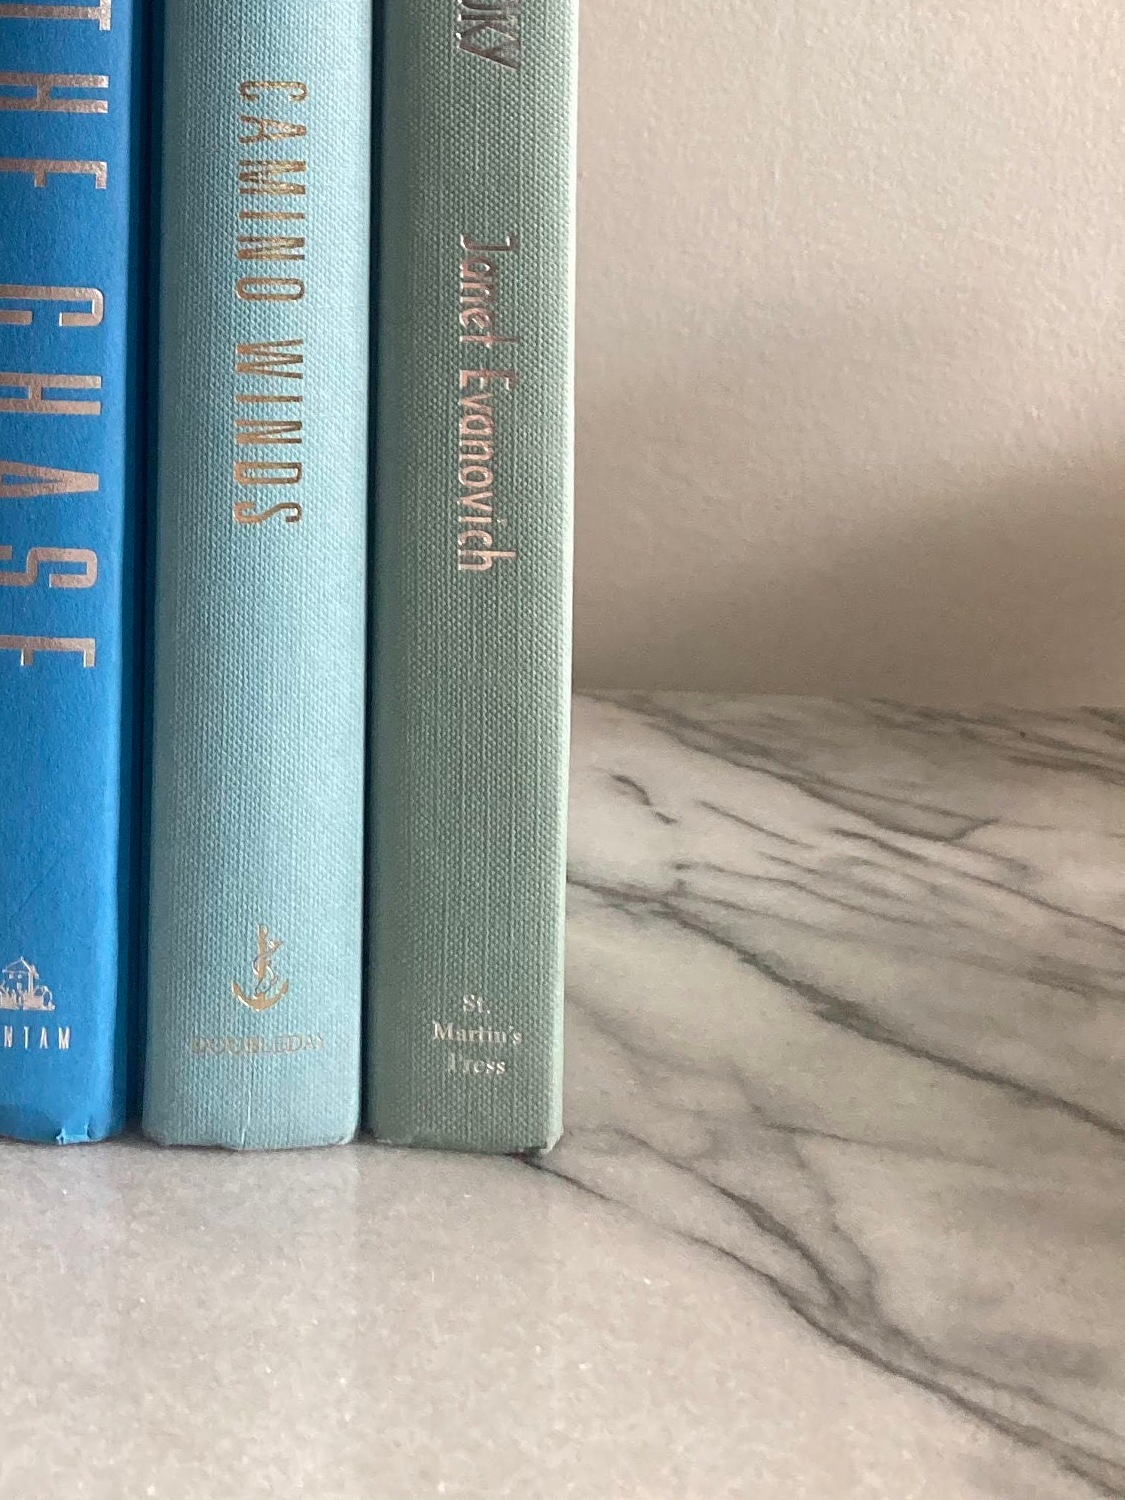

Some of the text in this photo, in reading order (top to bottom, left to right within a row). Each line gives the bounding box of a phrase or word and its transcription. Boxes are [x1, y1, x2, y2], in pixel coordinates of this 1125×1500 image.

[232, 80, 307, 526] CAMINO WINDS
[456, 234, 521, 572] Janet Evanovich
[433, 1020, 523, 1046] Martin's
[462, 994, 492, 1015] St.
